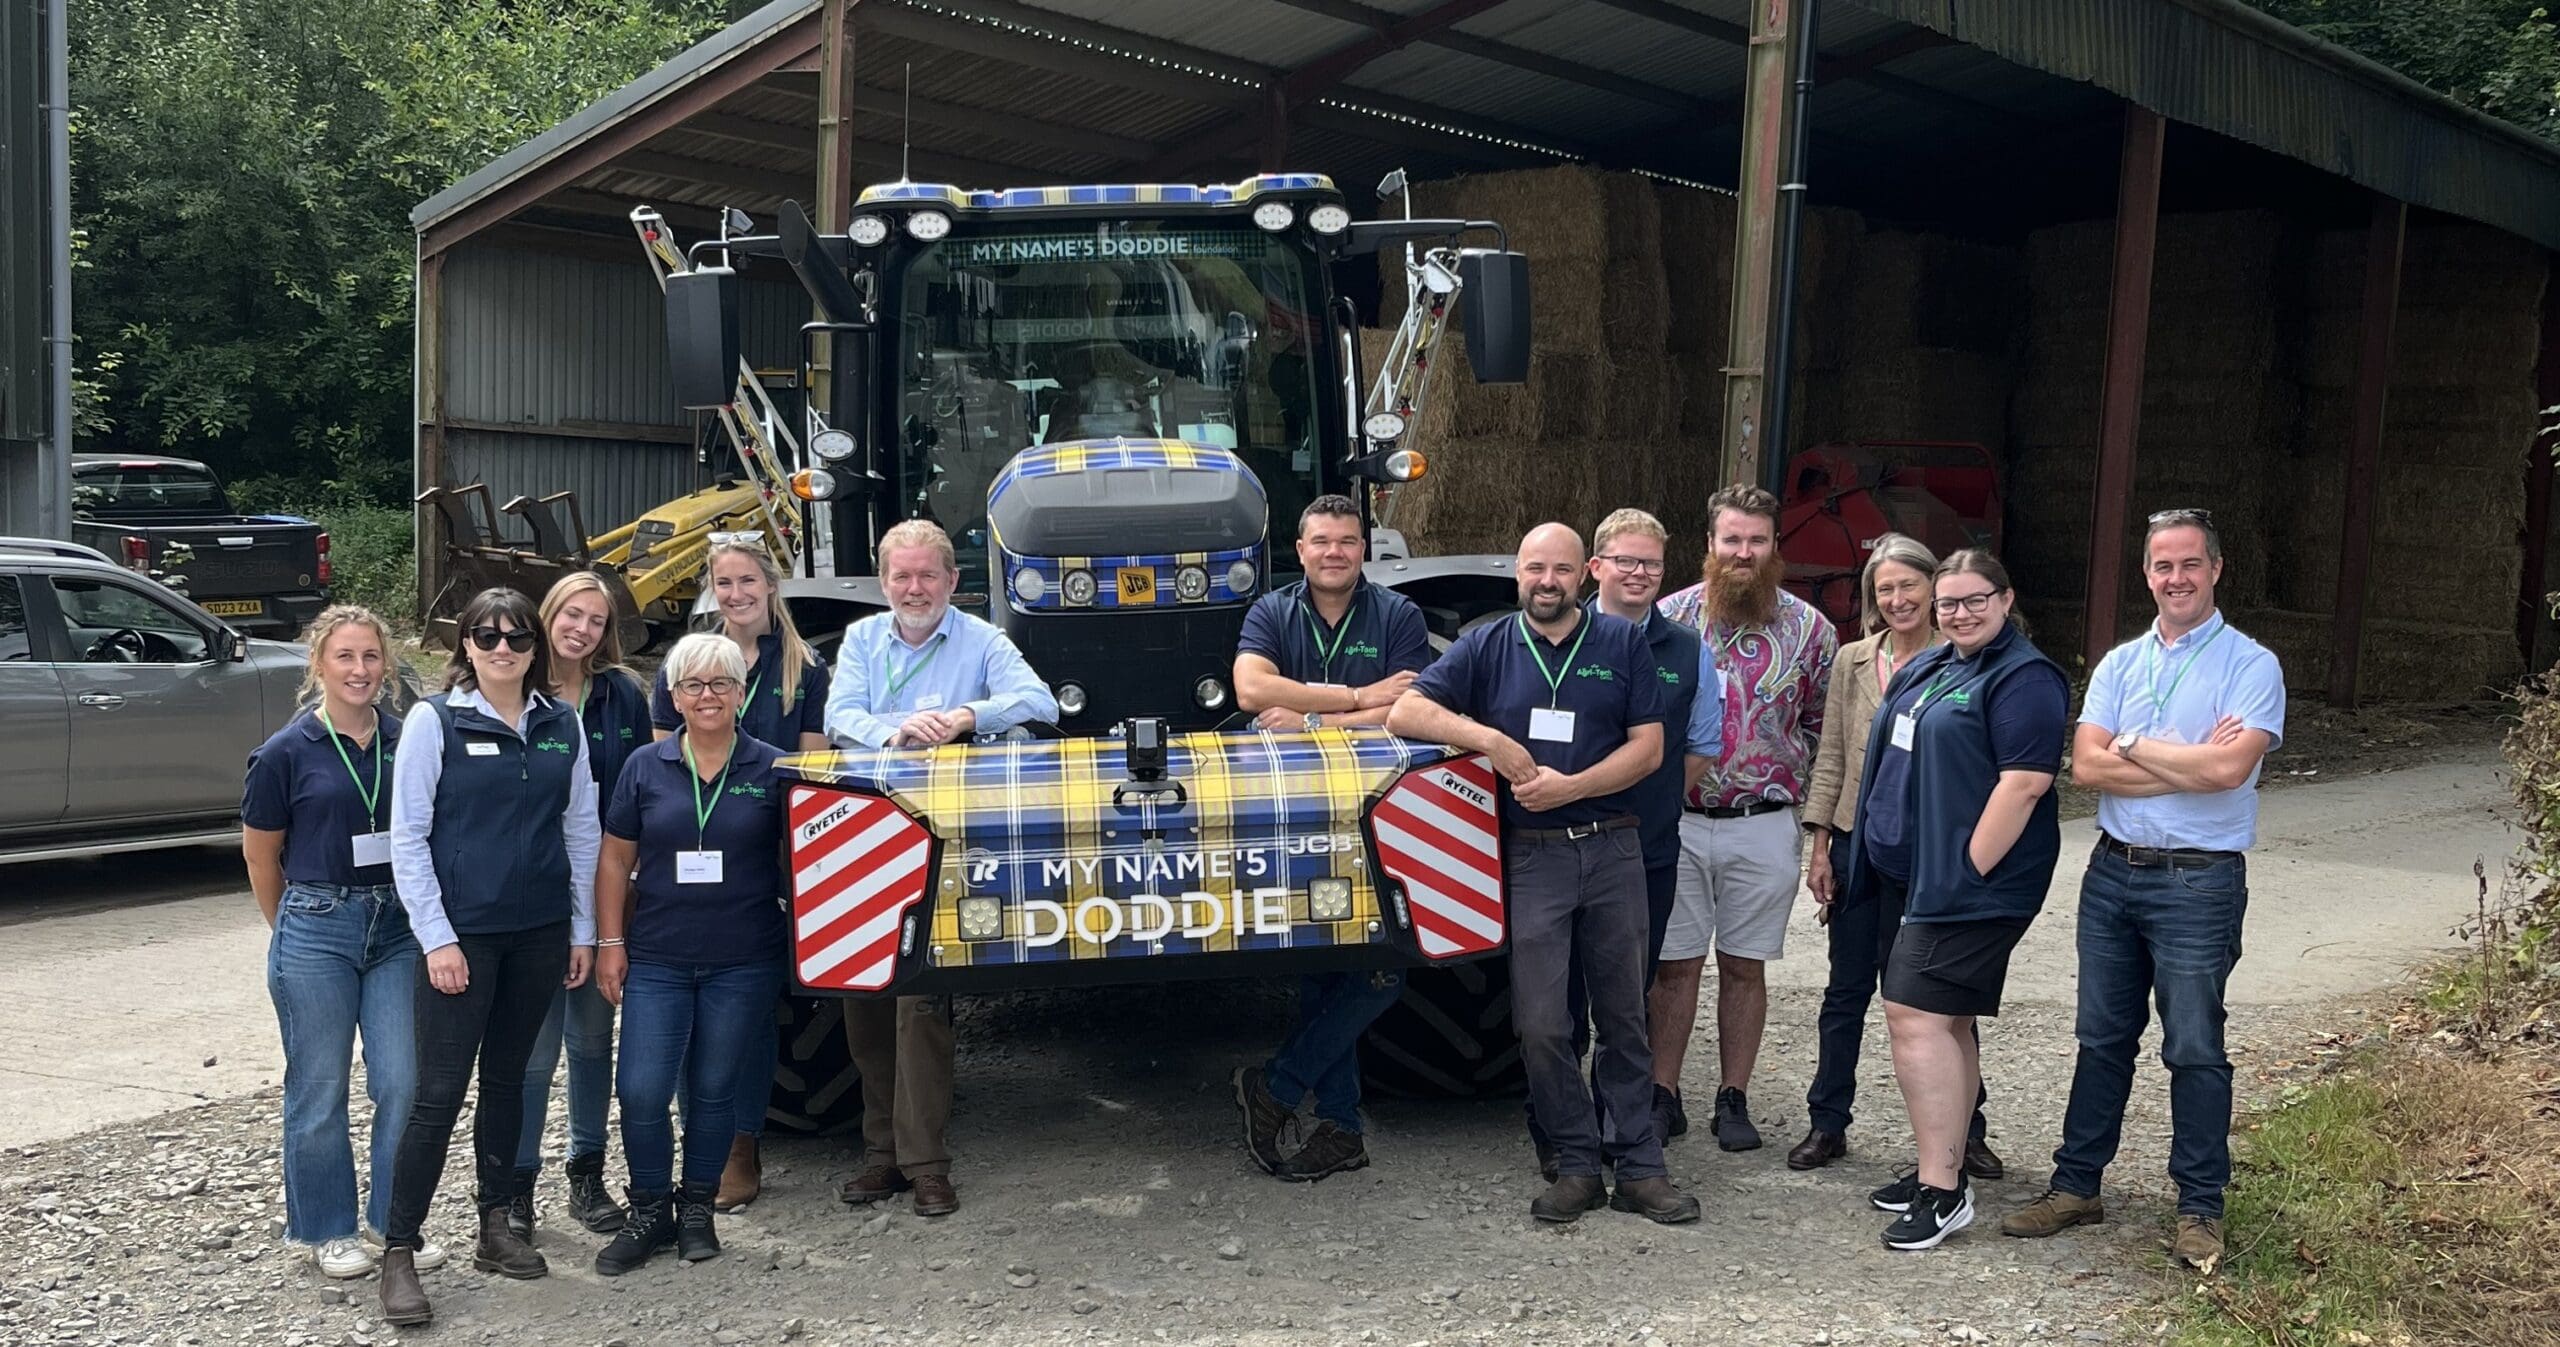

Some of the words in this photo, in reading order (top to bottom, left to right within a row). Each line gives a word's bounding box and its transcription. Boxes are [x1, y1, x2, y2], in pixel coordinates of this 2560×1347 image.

[973, 242, 1005, 261] MY
[1101, 237, 1188, 255] DODDIE
[1193, 244, 1239, 254] foundation
[1126, 575, 1149, 594] JCB
[206, 602, 236, 614] SD23
[237, 601, 258, 613] ZXA
[1444, 777, 1487, 806] RYETEC
[808, 802, 850, 837] RYETEC
[1288, 834, 1353, 856] JCB
[1042, 857, 1099, 887] MY
[1025, 886, 1291, 948] DODDIE
